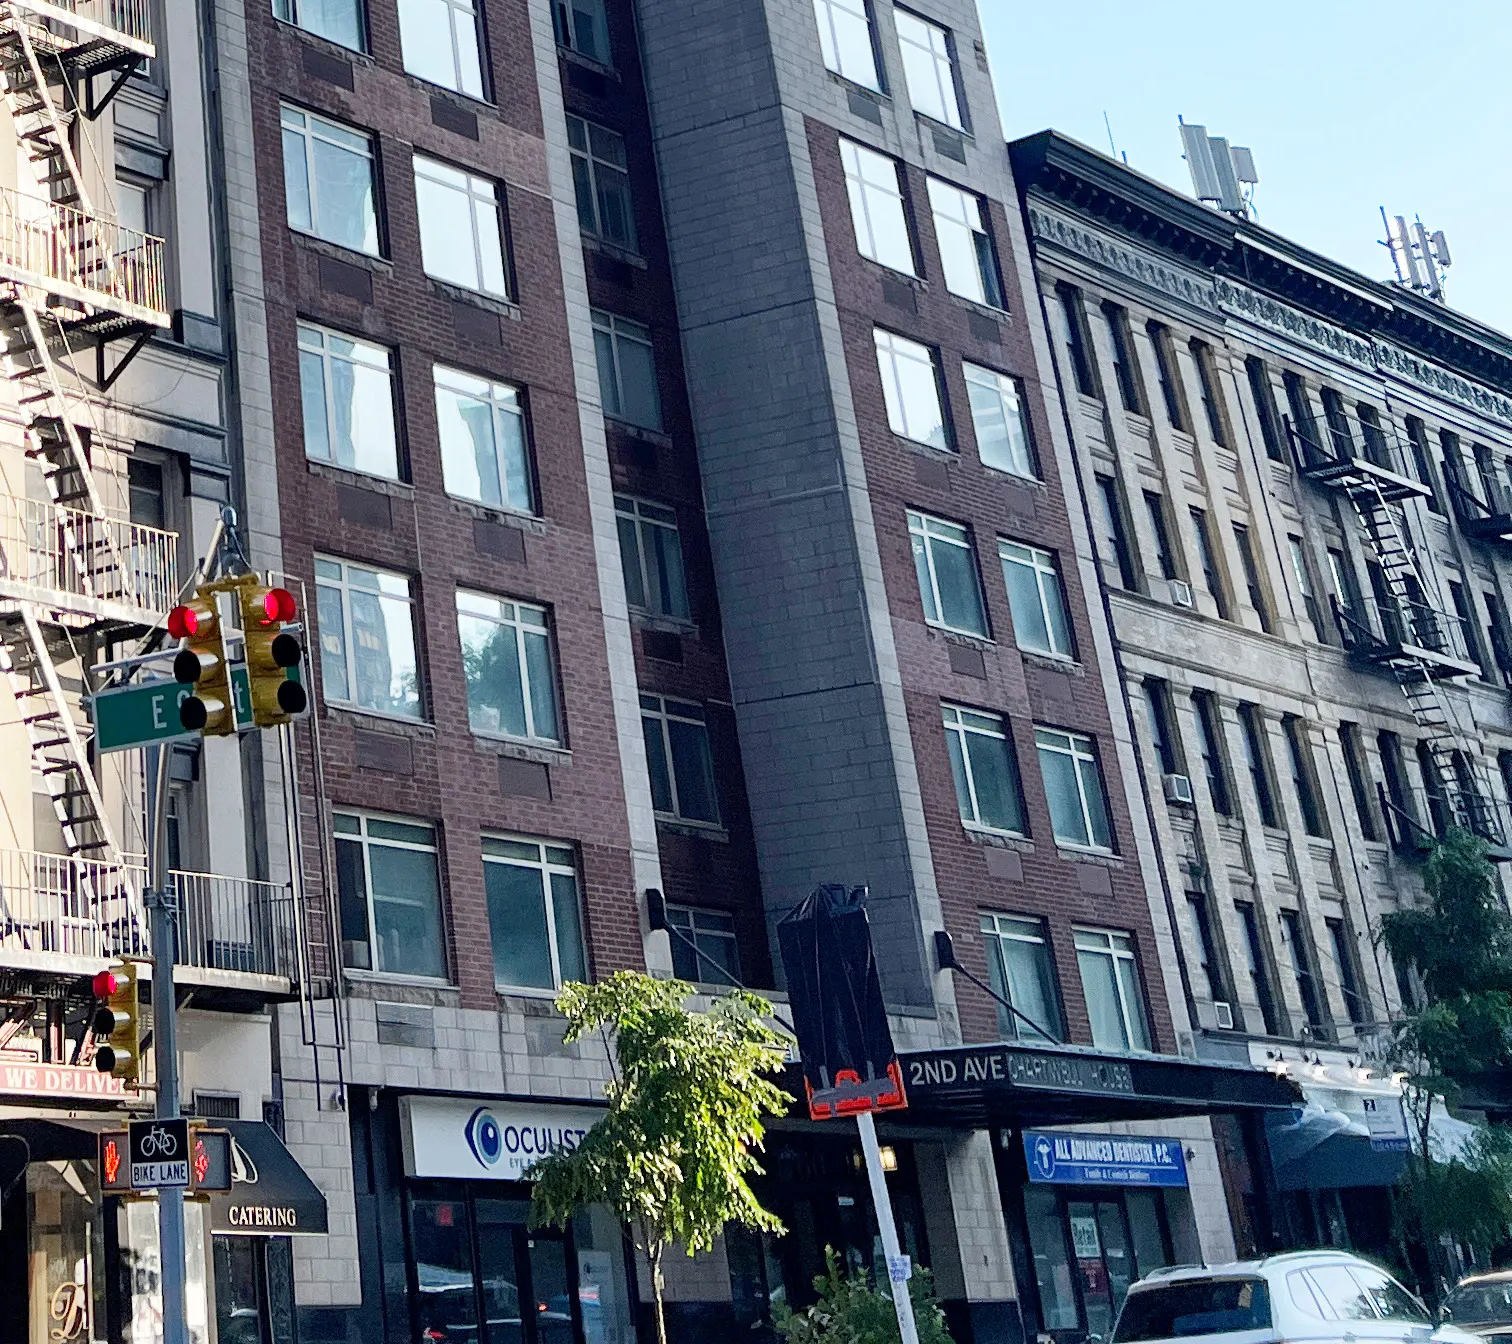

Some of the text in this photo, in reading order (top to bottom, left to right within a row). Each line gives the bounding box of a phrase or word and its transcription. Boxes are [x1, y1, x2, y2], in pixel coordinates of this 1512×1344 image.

[152, 694, 167, 729] E
[4, 1067, 38, 1089] WE
[44, 1069, 126, 1095] DELIVE
[910, 1055, 1005, 1086] 2ND AVE
[1054, 1138, 1071, 1160] ALL
[1070, 1139, 1113, 1162] ADVANCED
[133, 1163, 186, 1182] BIKE LANE
[228, 1206, 297, 1227] CATERING
